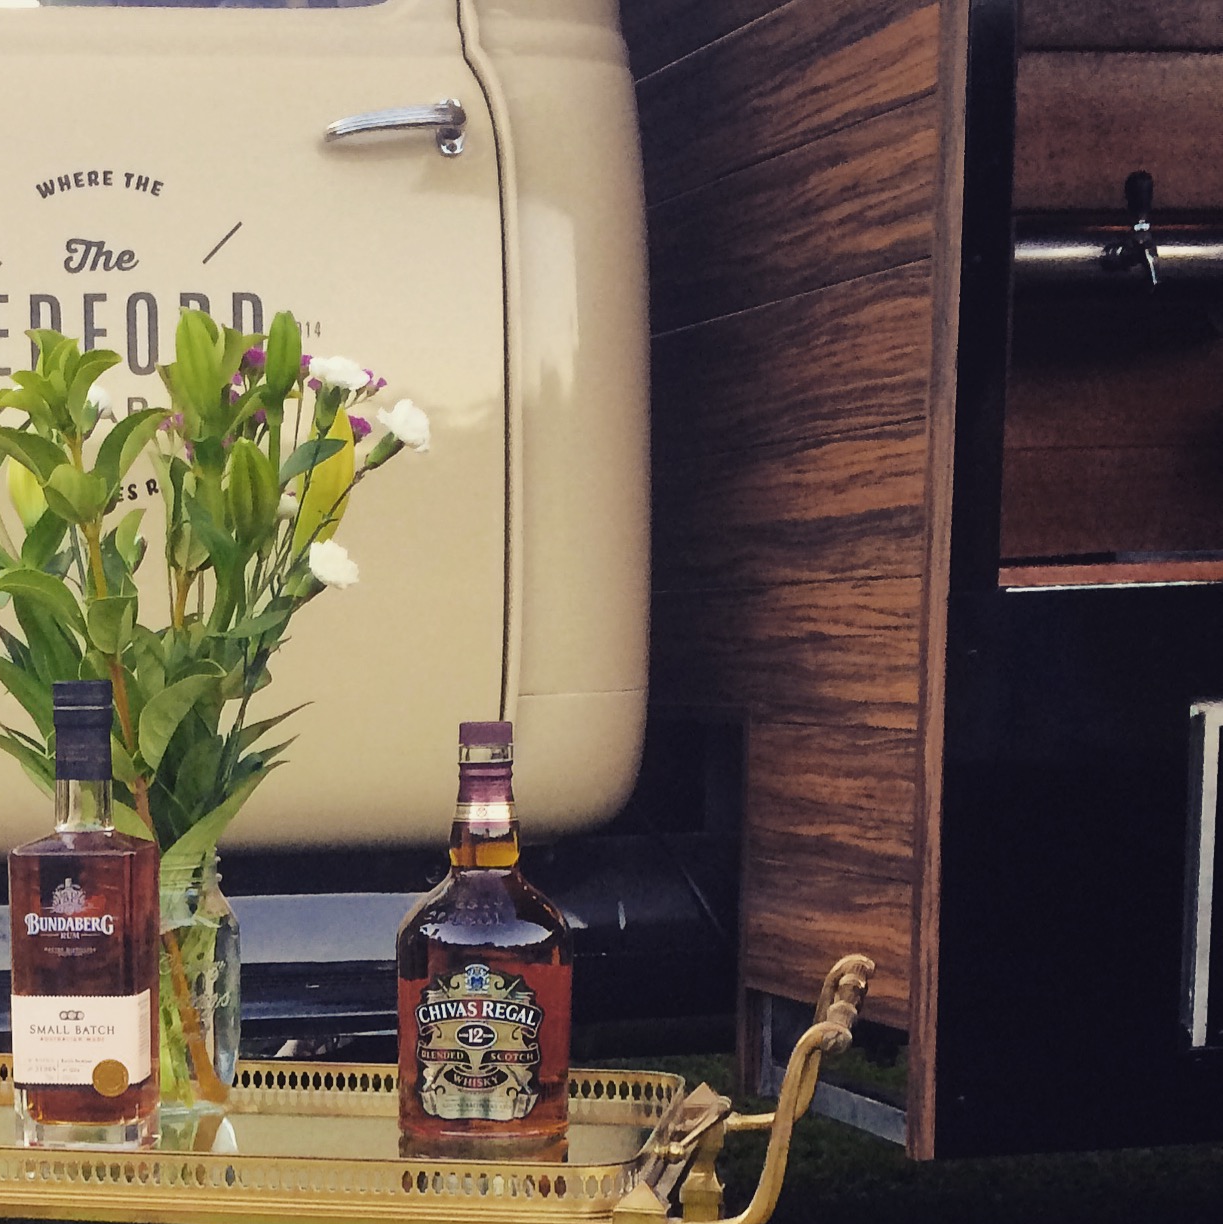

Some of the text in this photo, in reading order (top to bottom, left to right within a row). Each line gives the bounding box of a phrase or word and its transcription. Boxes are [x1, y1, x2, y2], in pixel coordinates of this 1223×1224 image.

[35, 169, 166, 200] WHERE THE
[63, 237, 140, 275] The
[24, 912, 115, 936] BUNDABERG
[59, 932, 81, 940] RUM
[418, 1000, 536, 1026] CHIVAS REGAL
[29, 1024, 115, 1035] SMALL BATCH
[467, 1027, 484, 1044] 12
[421, 1050, 534, 1060] BLENDED SCOTCH
[453, 1073, 498, 1087] WHISKY
